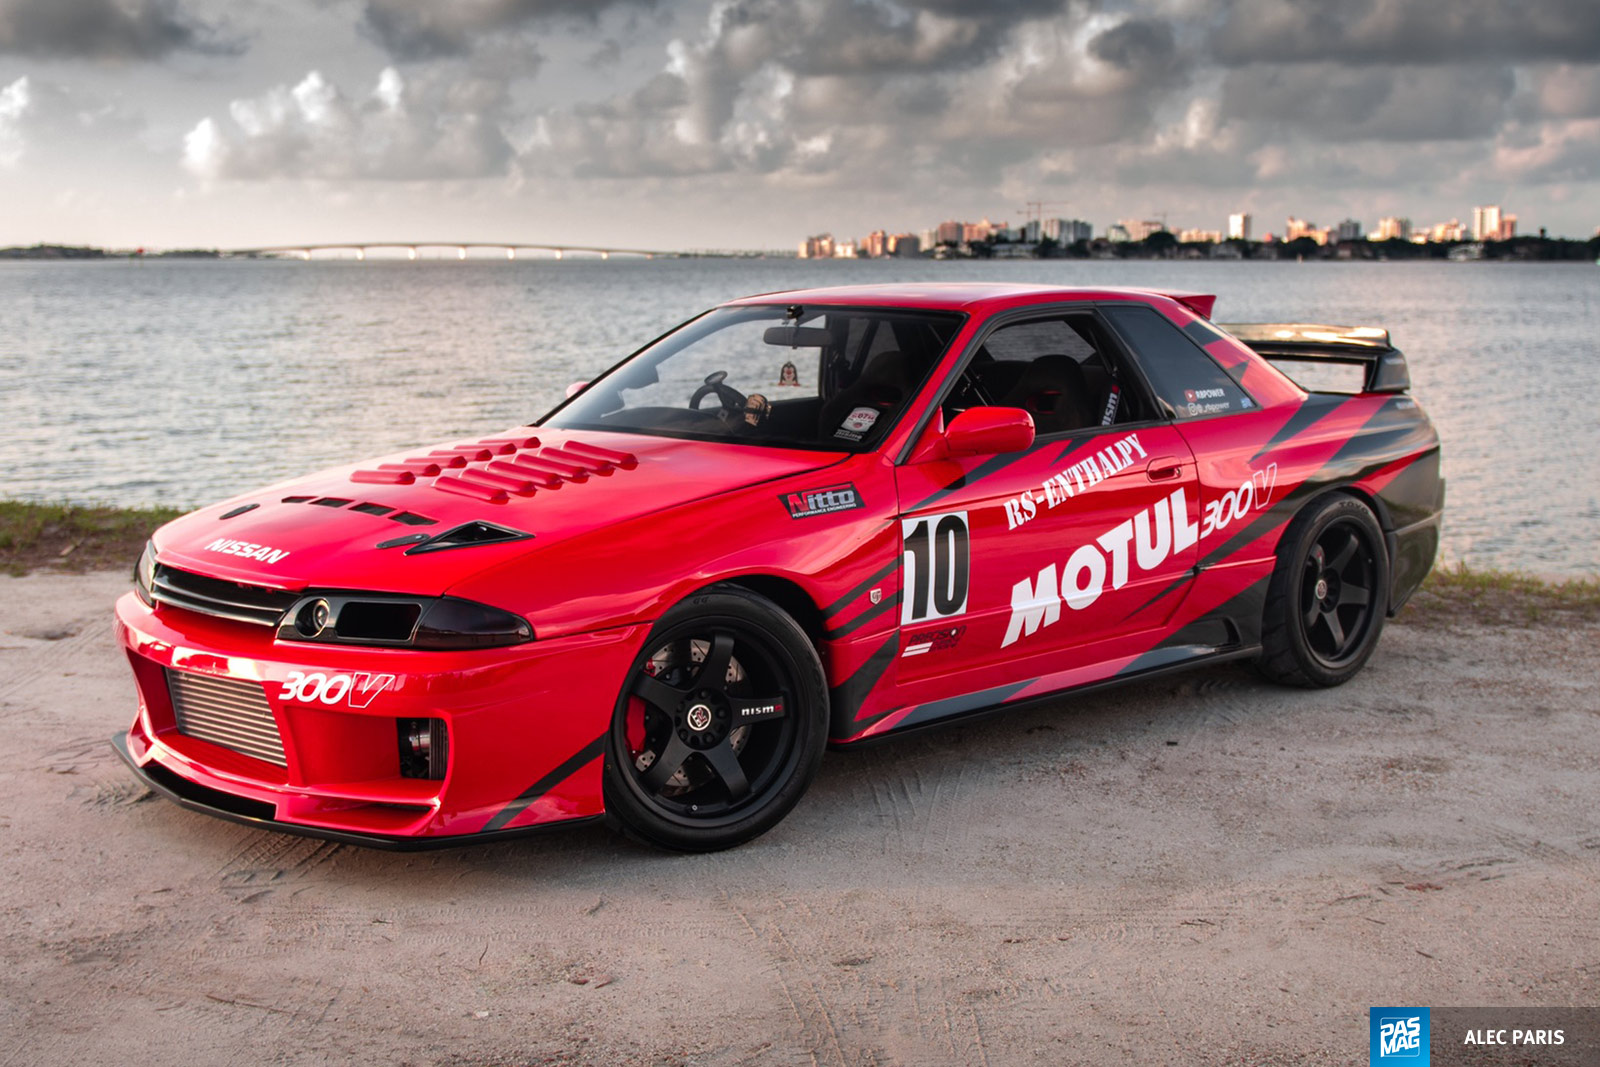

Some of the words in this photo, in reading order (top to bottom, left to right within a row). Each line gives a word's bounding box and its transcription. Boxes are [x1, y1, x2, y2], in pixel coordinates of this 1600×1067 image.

[788, 484, 855, 513] Nitto
[1003, 433, 1147, 530] RS-ENTHALPY
[1199, 462, 1277, 539] 300V
[792, 508, 827, 518] PERFORMANCE
[827, 503, 857, 512] ENGINEERING
[204, 538, 290, 564] NISSAN
[904, 514, 969, 620] 10
[1000, 487, 1198, 649] MOTUL
[278, 671, 395, 708] 300V
